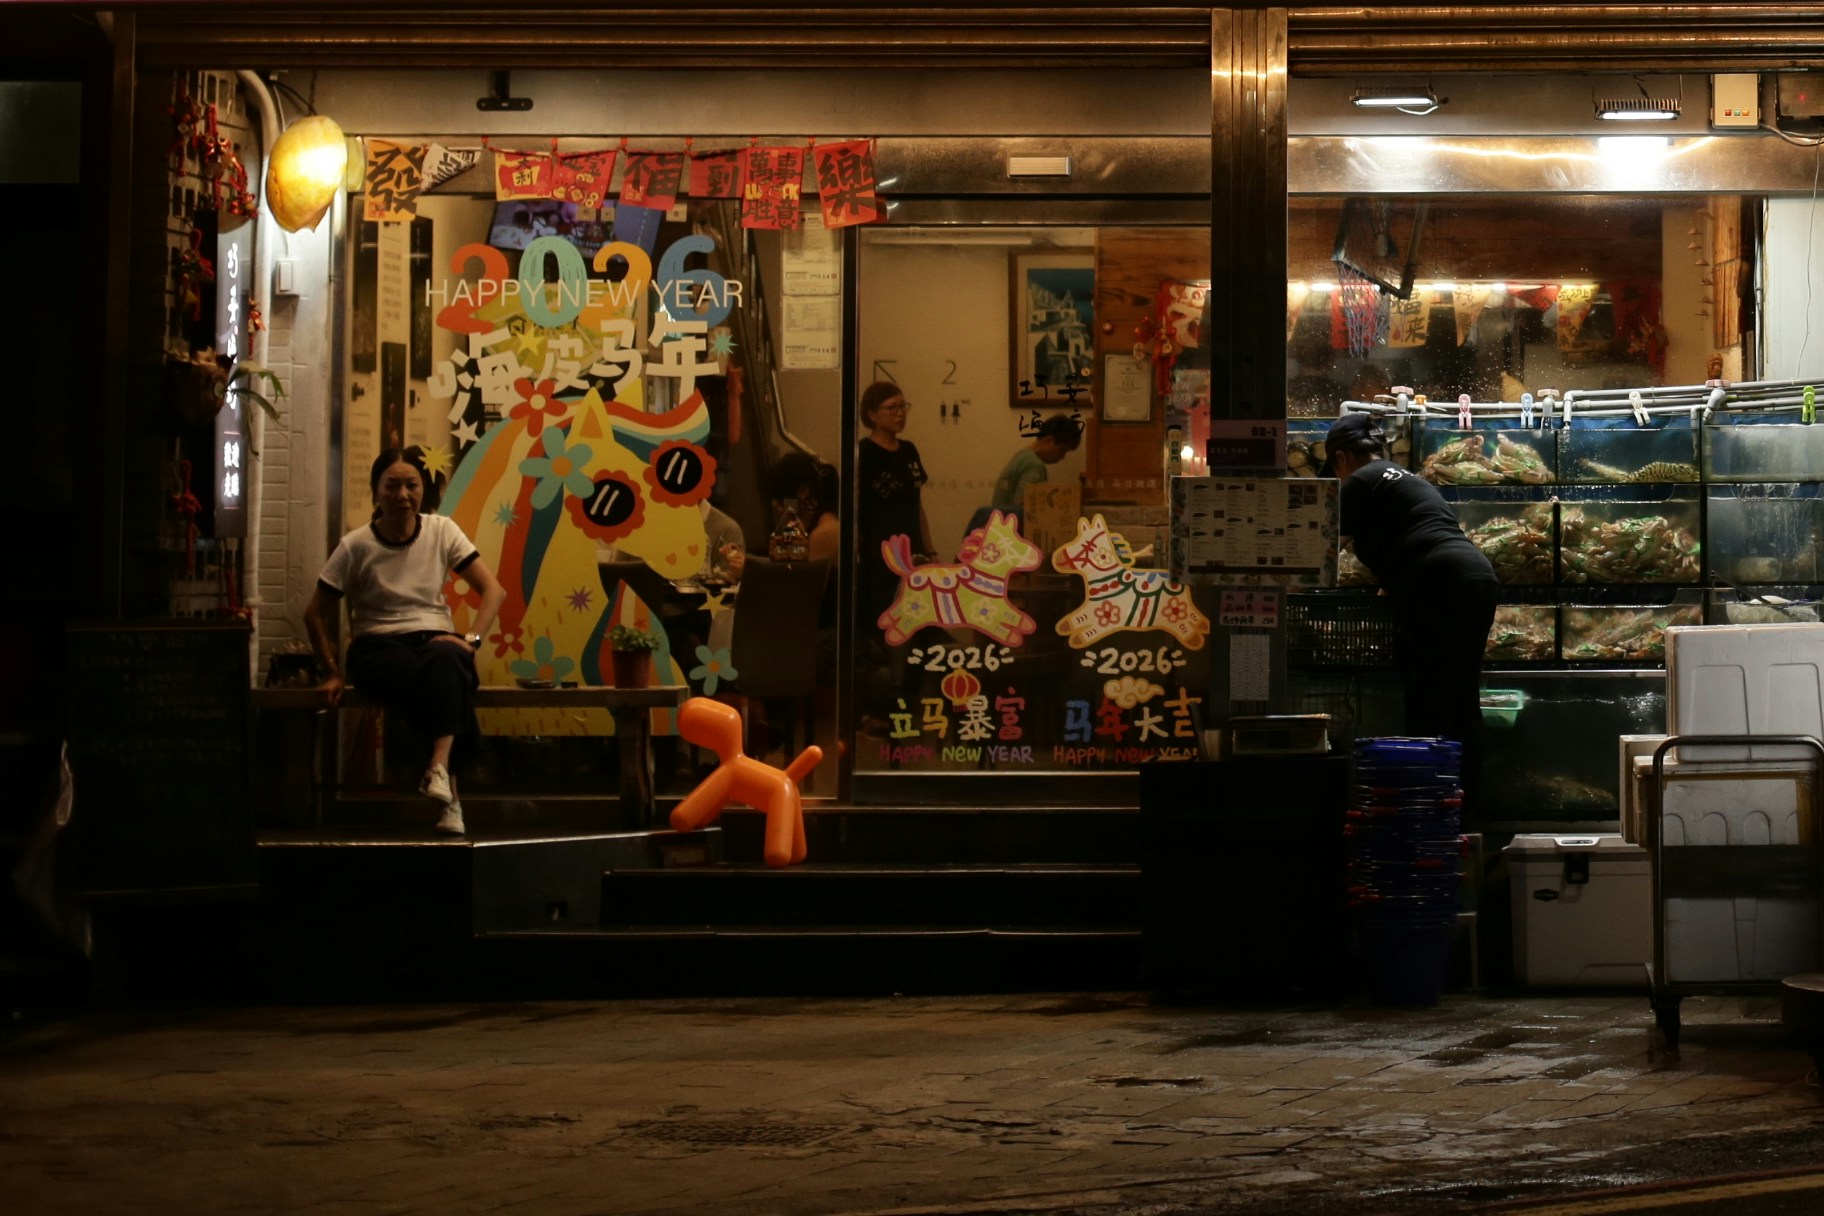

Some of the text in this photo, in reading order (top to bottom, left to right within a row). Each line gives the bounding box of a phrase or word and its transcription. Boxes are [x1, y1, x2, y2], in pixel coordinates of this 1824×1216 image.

[424, 278, 745, 308] HAPPY NEW YEAR
[436, 233, 734, 335] 2026
[924, 643, 1000, 672] 2026
[1096, 645, 1173, 675] 2026
[888, 686, 1027, 742] 立马暴富
[986, 745, 1035, 764] YEAR
[1053, 745, 1106, 765] HAPPY
